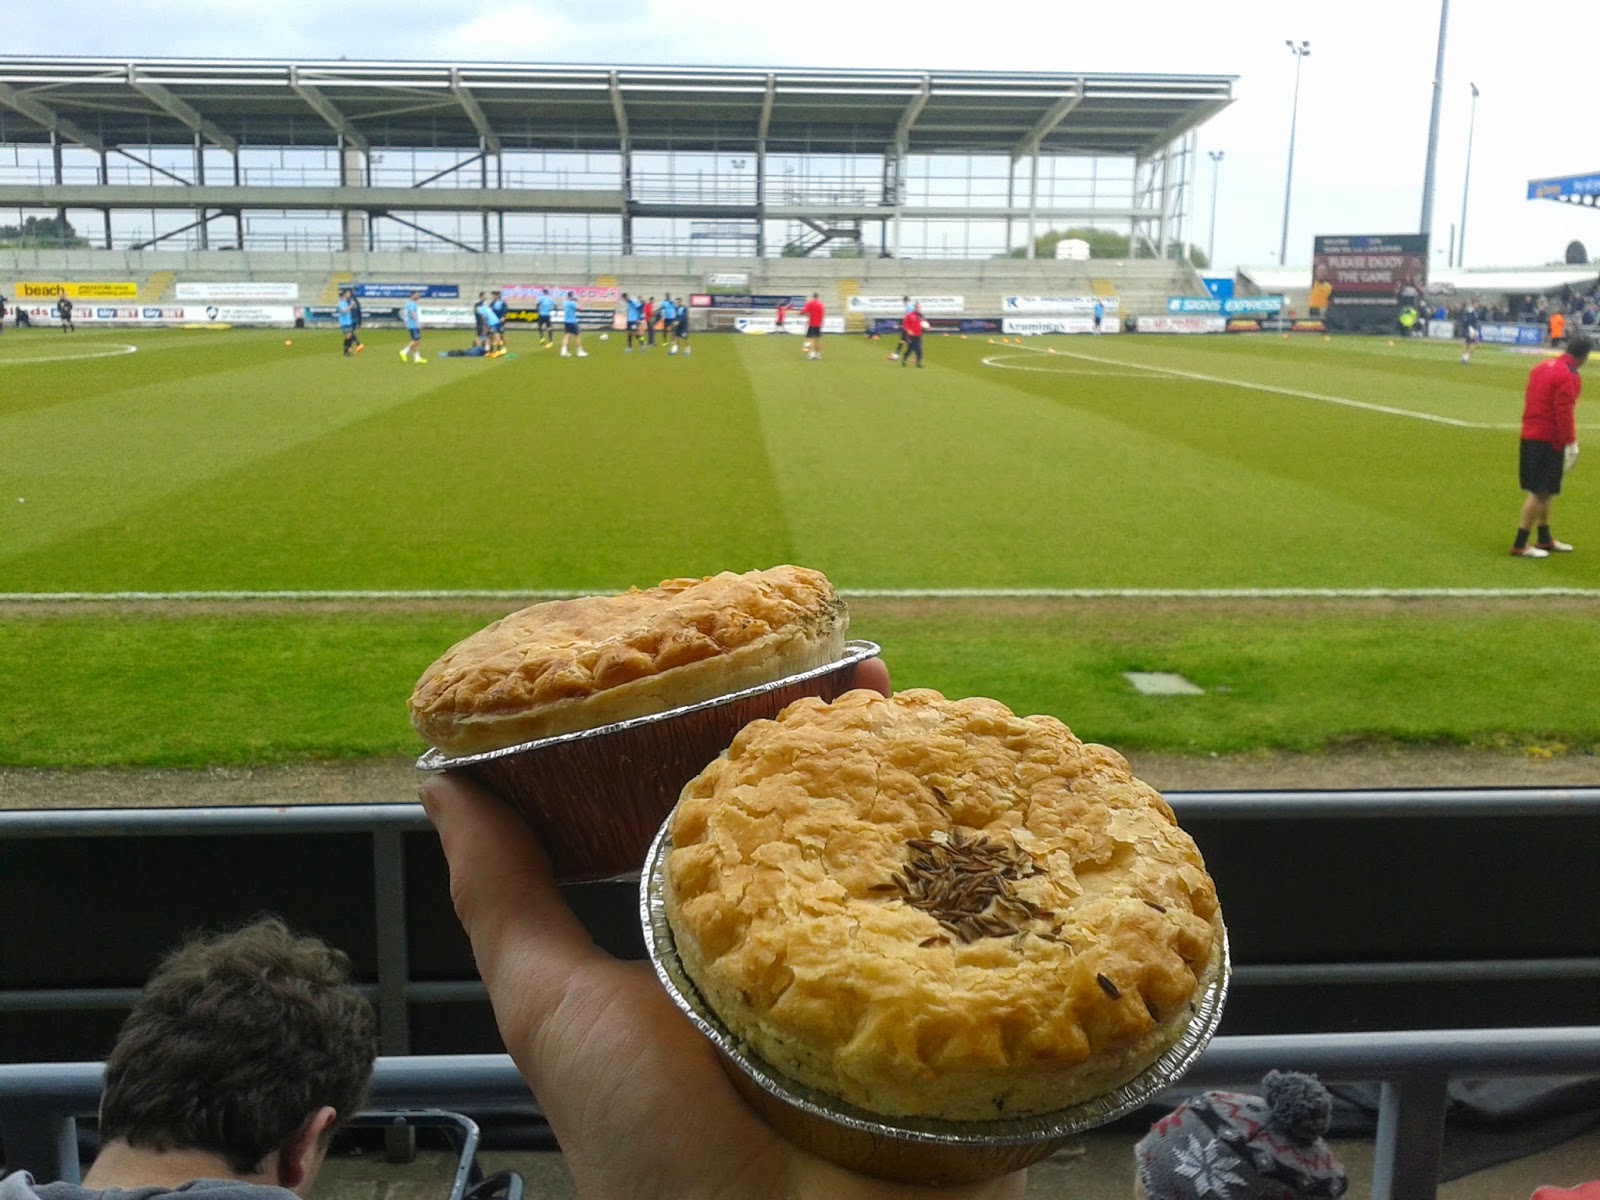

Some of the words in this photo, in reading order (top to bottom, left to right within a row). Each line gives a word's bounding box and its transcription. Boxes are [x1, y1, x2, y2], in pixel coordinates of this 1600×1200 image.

[1327, 256, 1366, 269] PLEASE
[1367, 256, 1404, 268] ENJOY
[1338, 271, 1359, 283] THE
[1360, 271, 1392, 283] GAME
[24, 284, 65, 297] beach
[1182, 299, 1221, 311] SIGNS
